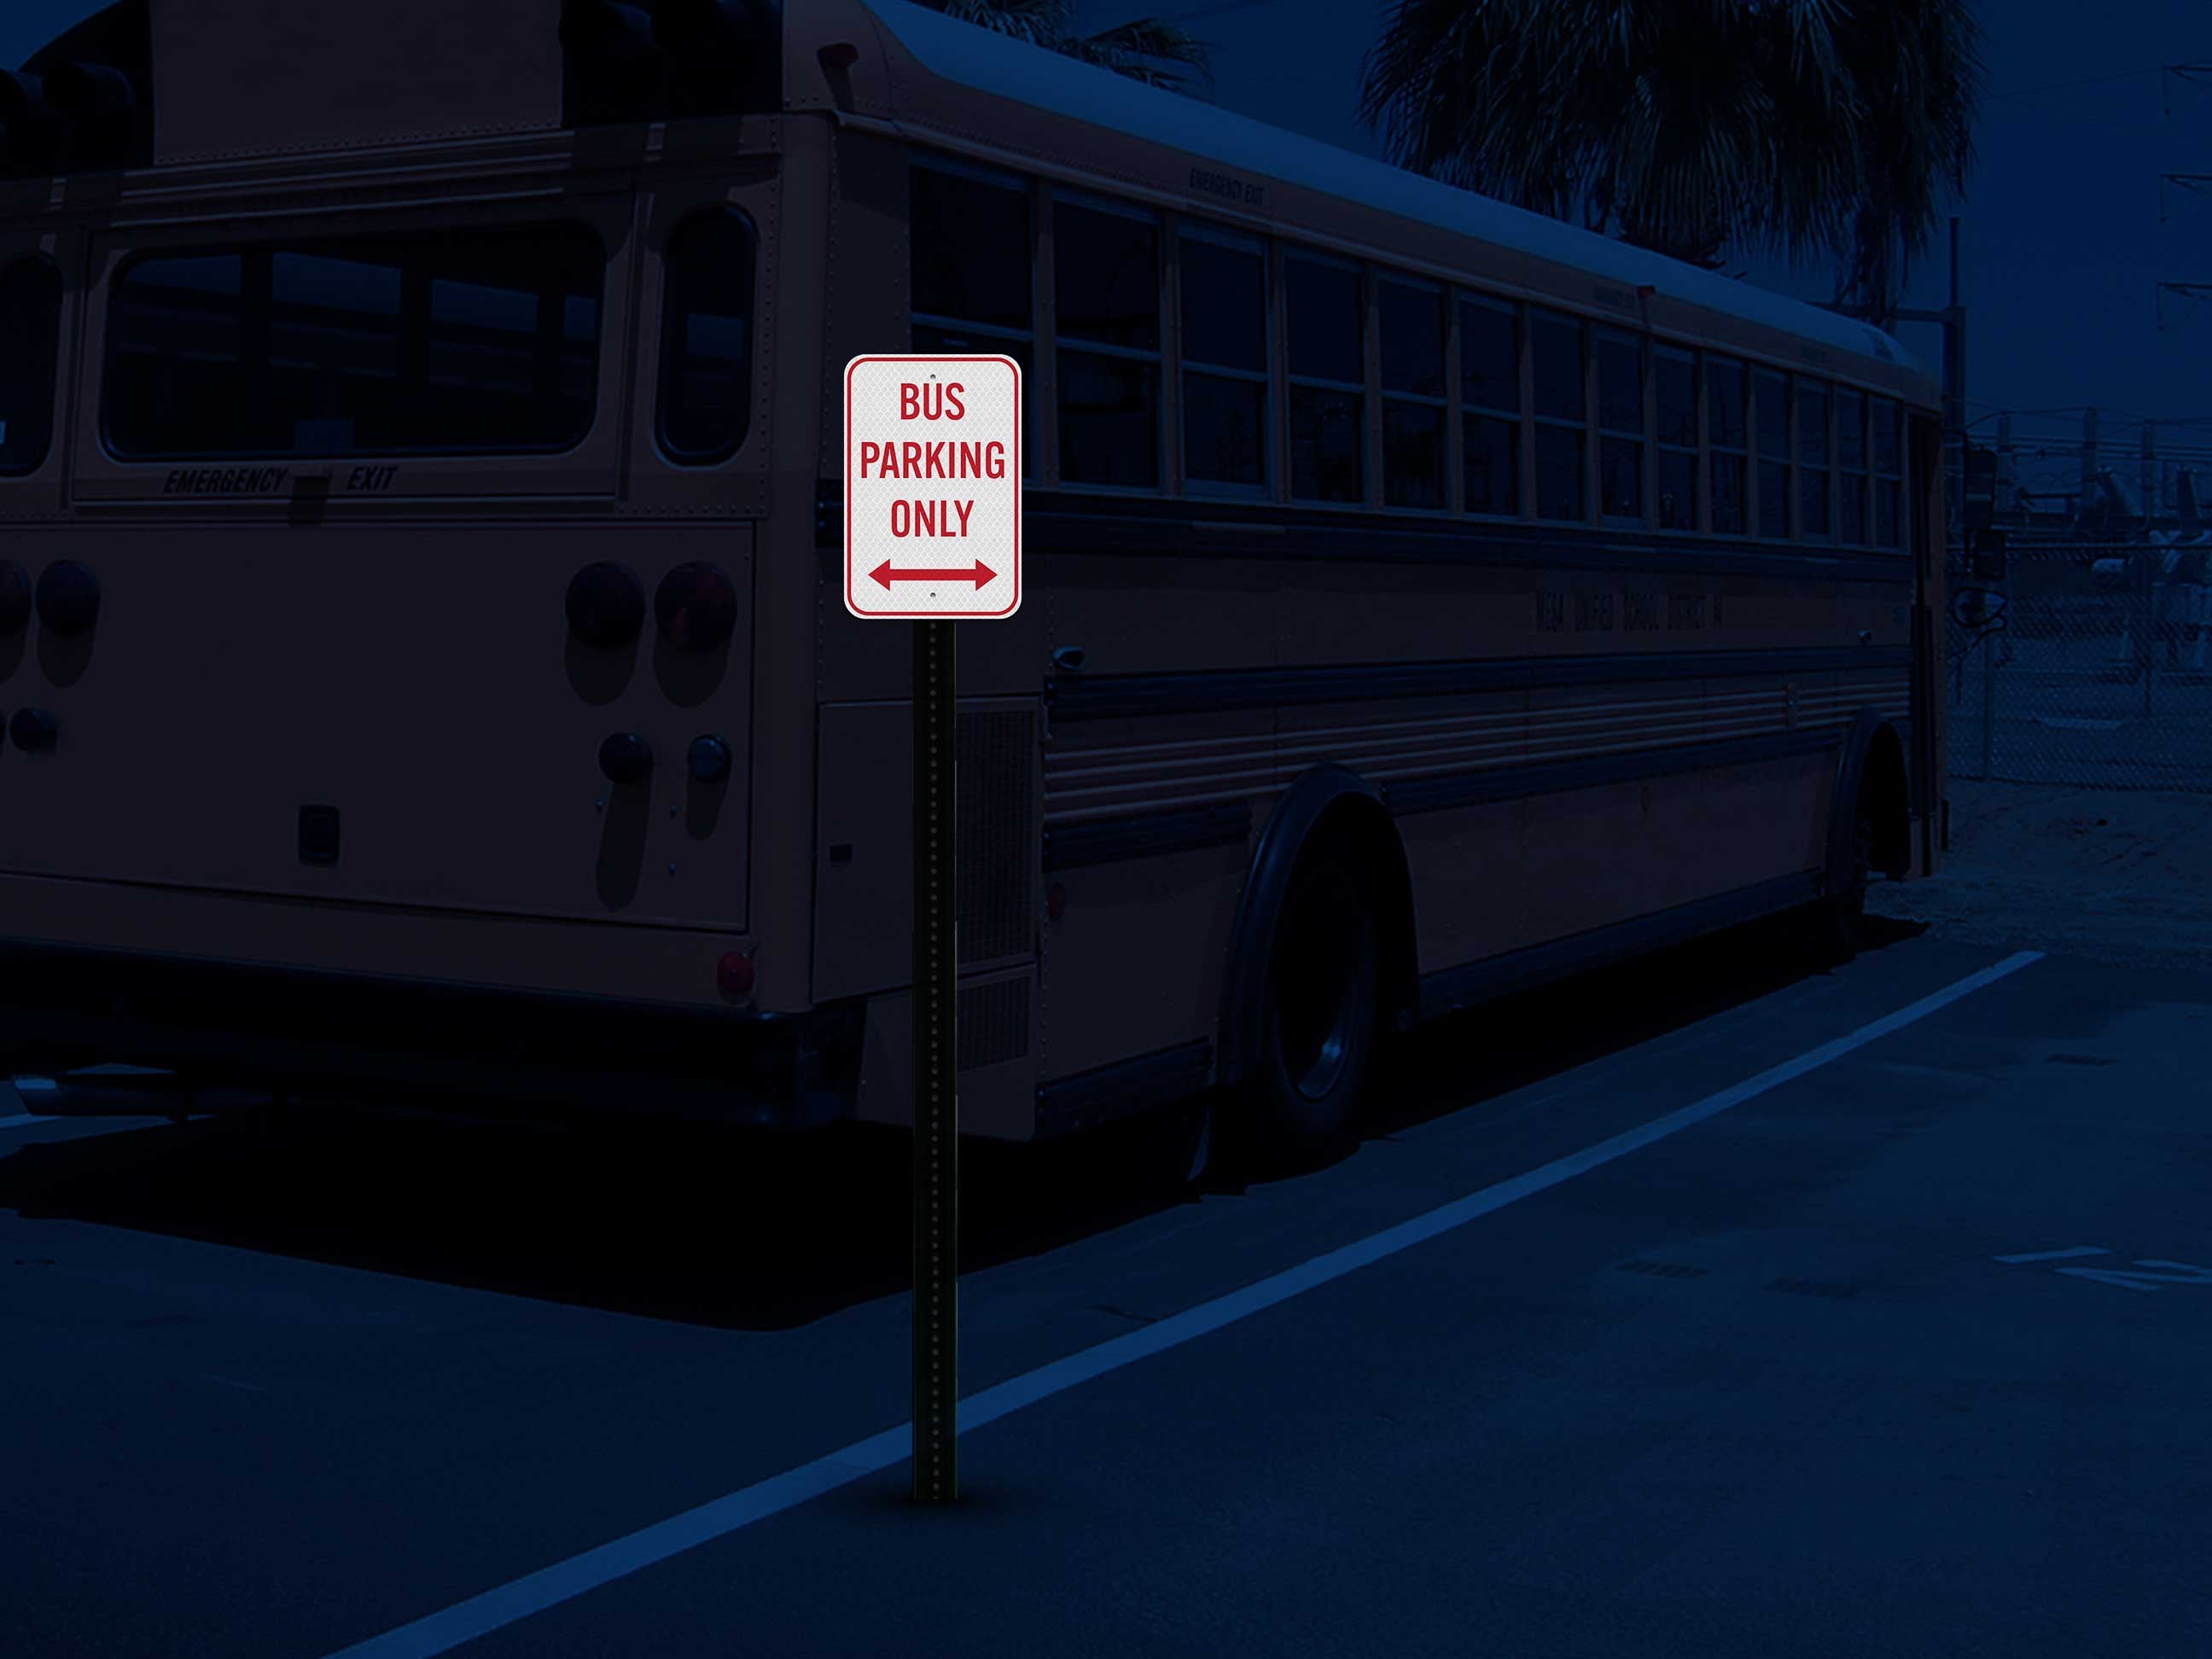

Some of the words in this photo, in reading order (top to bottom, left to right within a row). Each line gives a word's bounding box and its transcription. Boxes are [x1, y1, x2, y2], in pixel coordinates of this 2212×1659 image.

[900, 382, 964, 420] BUS
[861, 441, 1004, 479] PARKING
[163, 468, 288, 493] EMERGENCY
[346, 466, 399, 491] EXIT
[891, 499, 974, 537] ONLY
